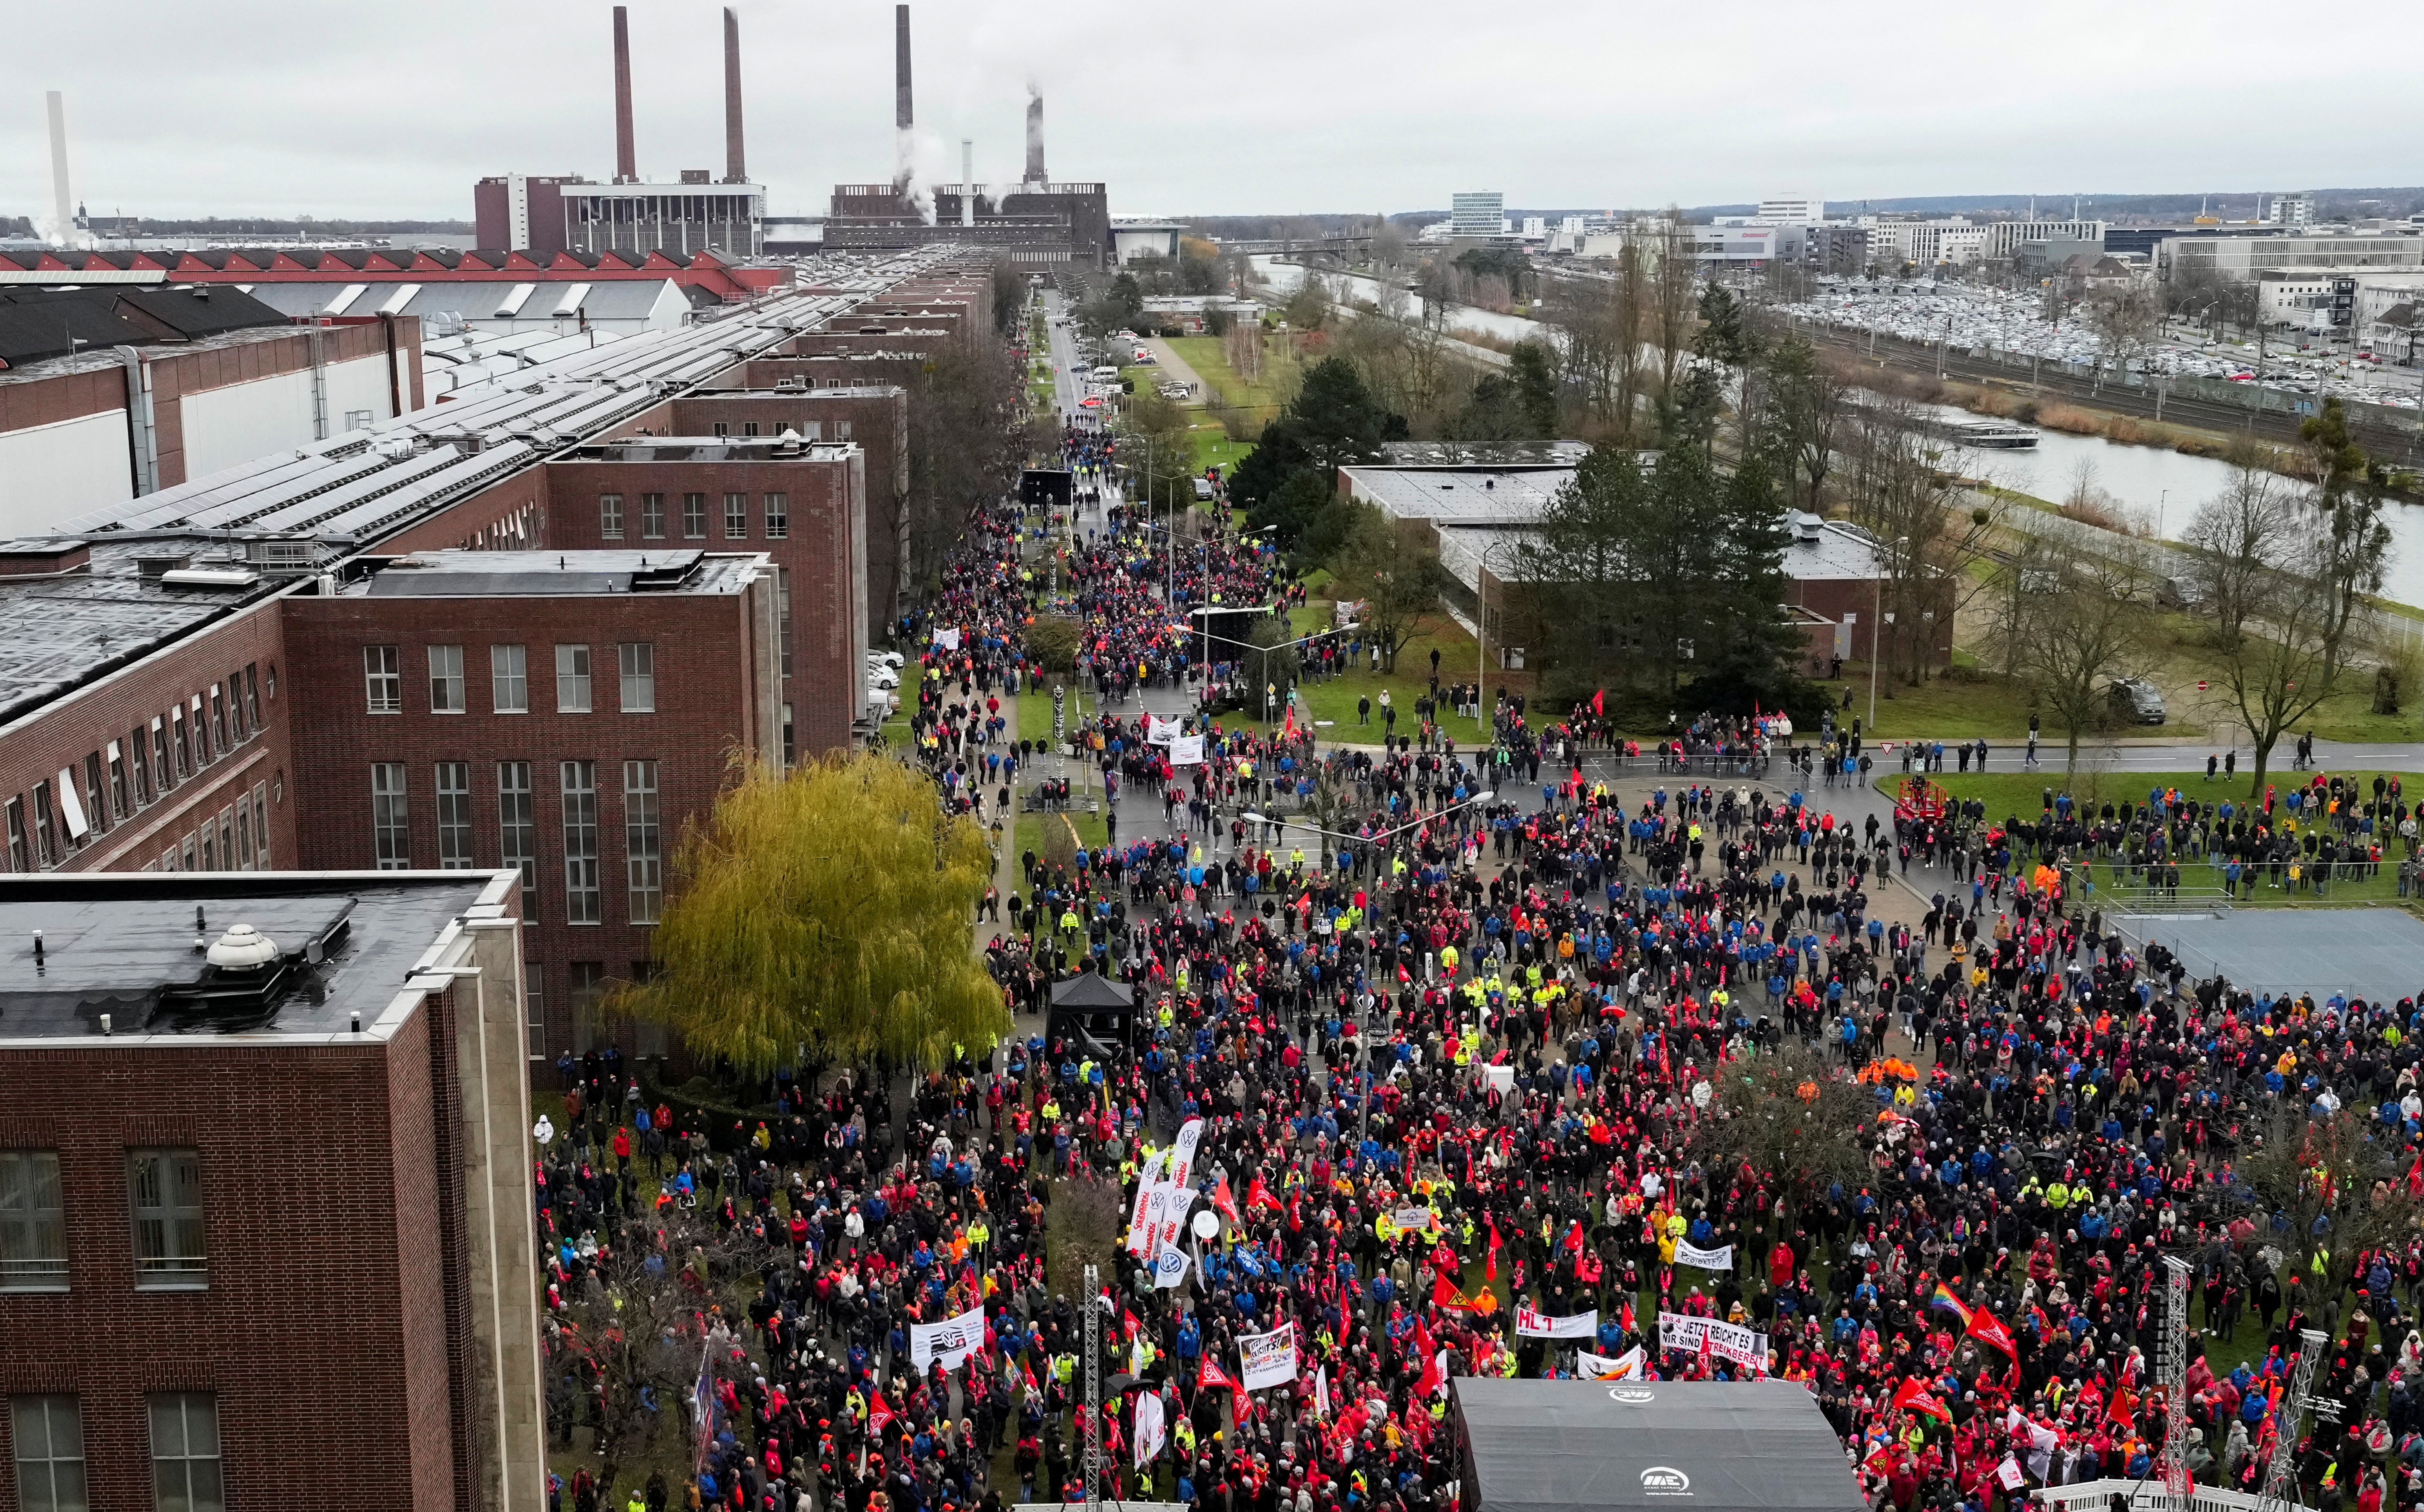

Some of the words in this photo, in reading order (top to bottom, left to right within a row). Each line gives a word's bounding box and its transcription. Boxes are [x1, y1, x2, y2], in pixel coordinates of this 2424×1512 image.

[1519, 1309, 1539, 1330] ML
[1679, 1336, 1700, 1348] SIND
[1710, 1326, 1738, 1348] REICHT
[1739, 1334, 1750, 1349] ES
[1977, 1329, 2009, 1351] WOLFSBURG
[1708, 1342, 1763, 1367] TREIKBEREIT
[1906, 1399, 1939, 1413] WOLFSBURG
